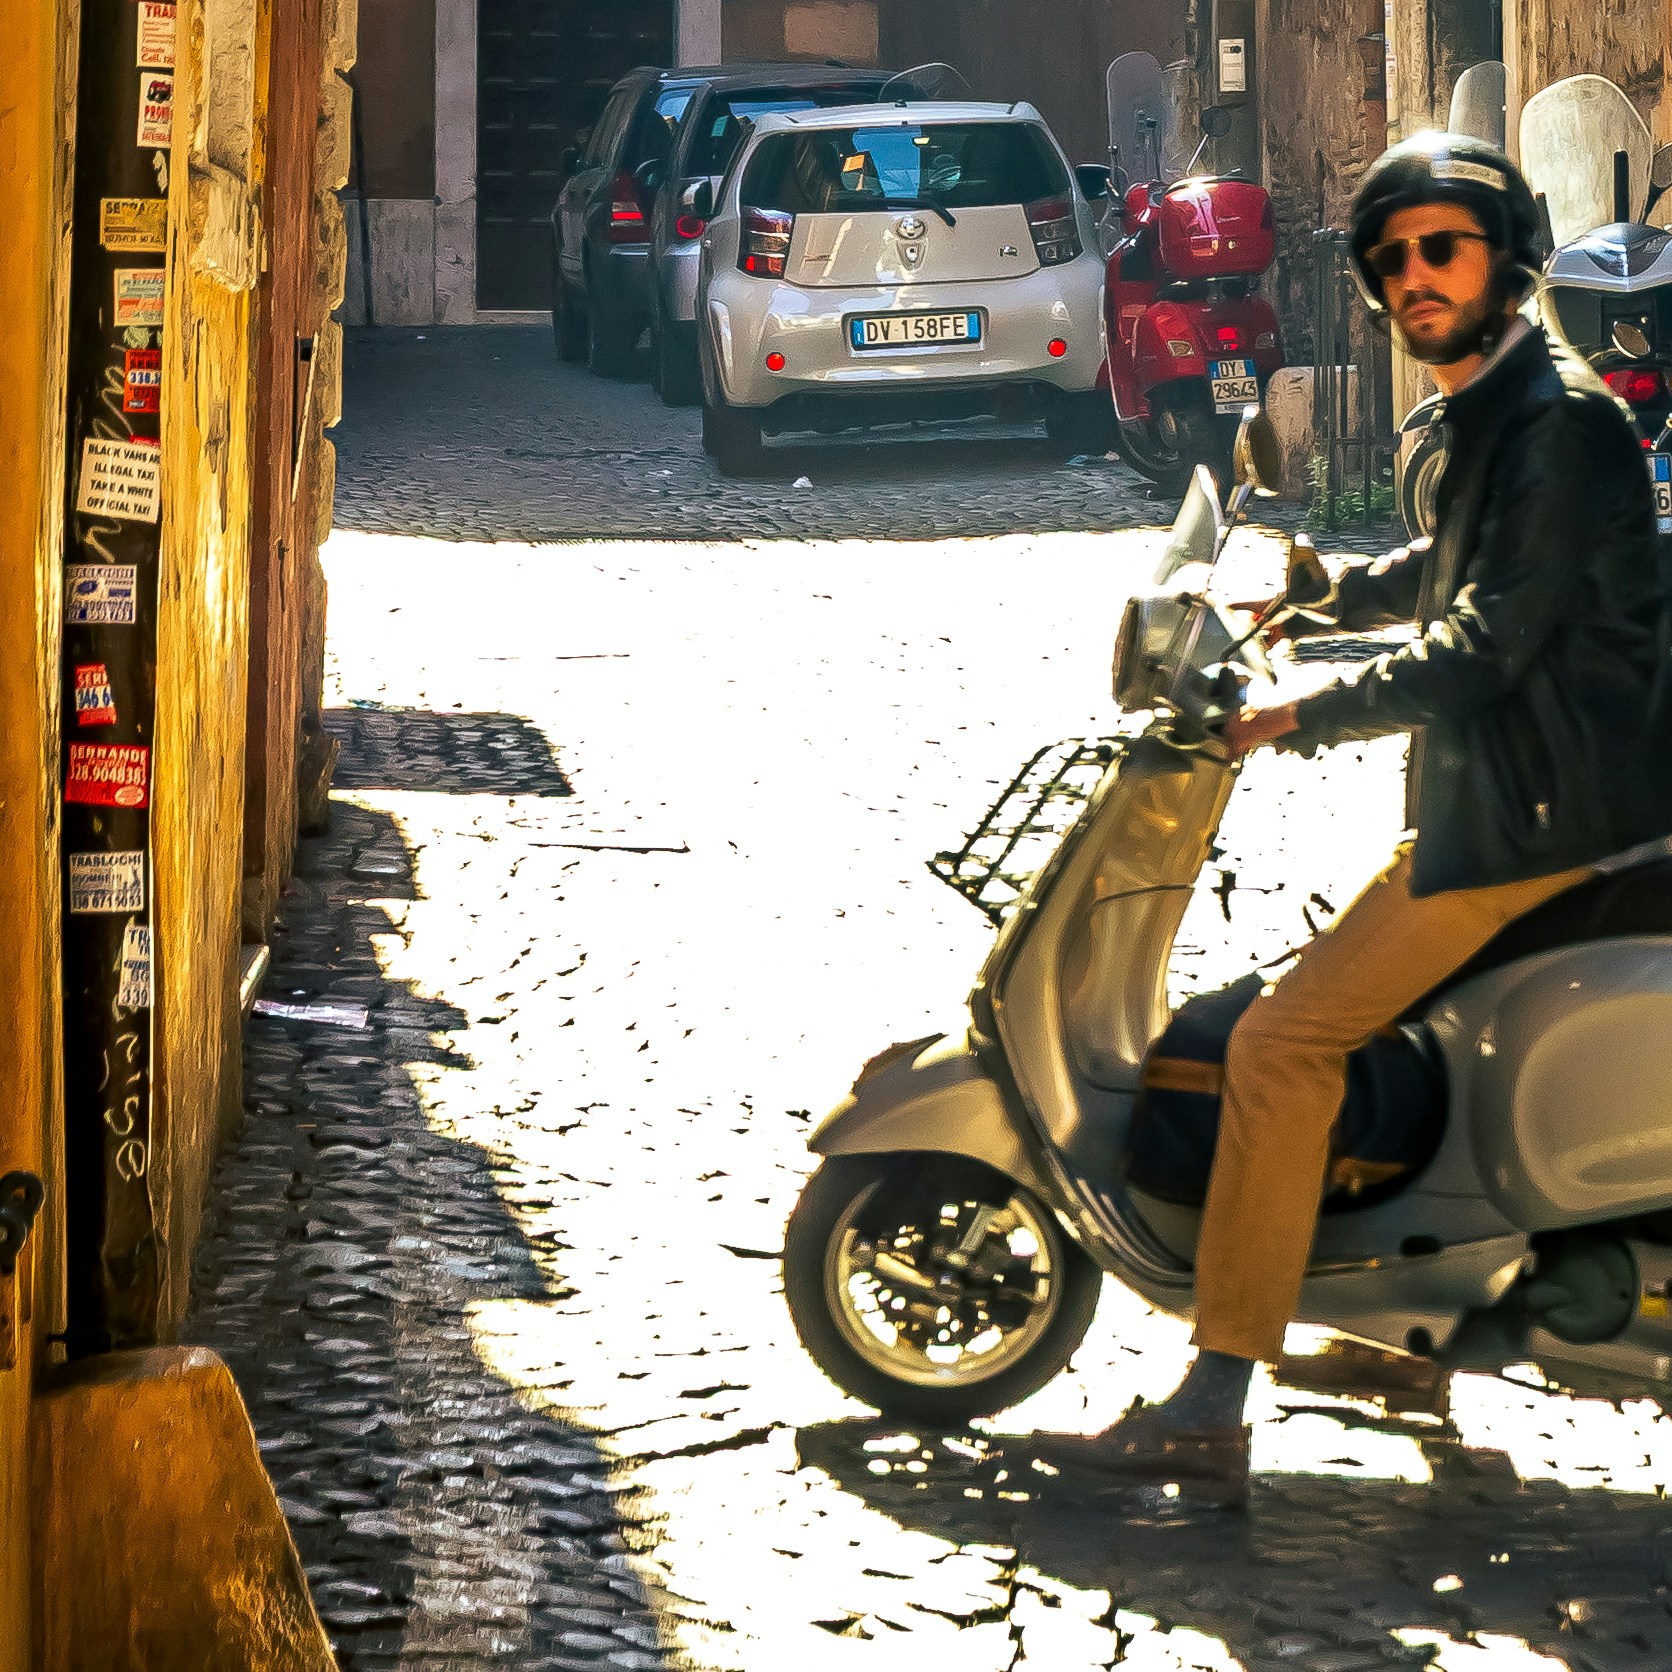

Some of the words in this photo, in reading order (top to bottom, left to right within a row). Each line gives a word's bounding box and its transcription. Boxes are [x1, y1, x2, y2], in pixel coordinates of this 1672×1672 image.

[901, 316, 966, 340] 158FE
[1219, 361, 1236, 377] DY
[88, 444, 121, 457] BLACK
[94, 462, 133, 477] ILLEGAL
[136, 468, 155, 481] TAXI
[117, 483, 125, 494] A
[127, 486, 153, 499] WHITE
[133, 503, 151, 516] TAXI
